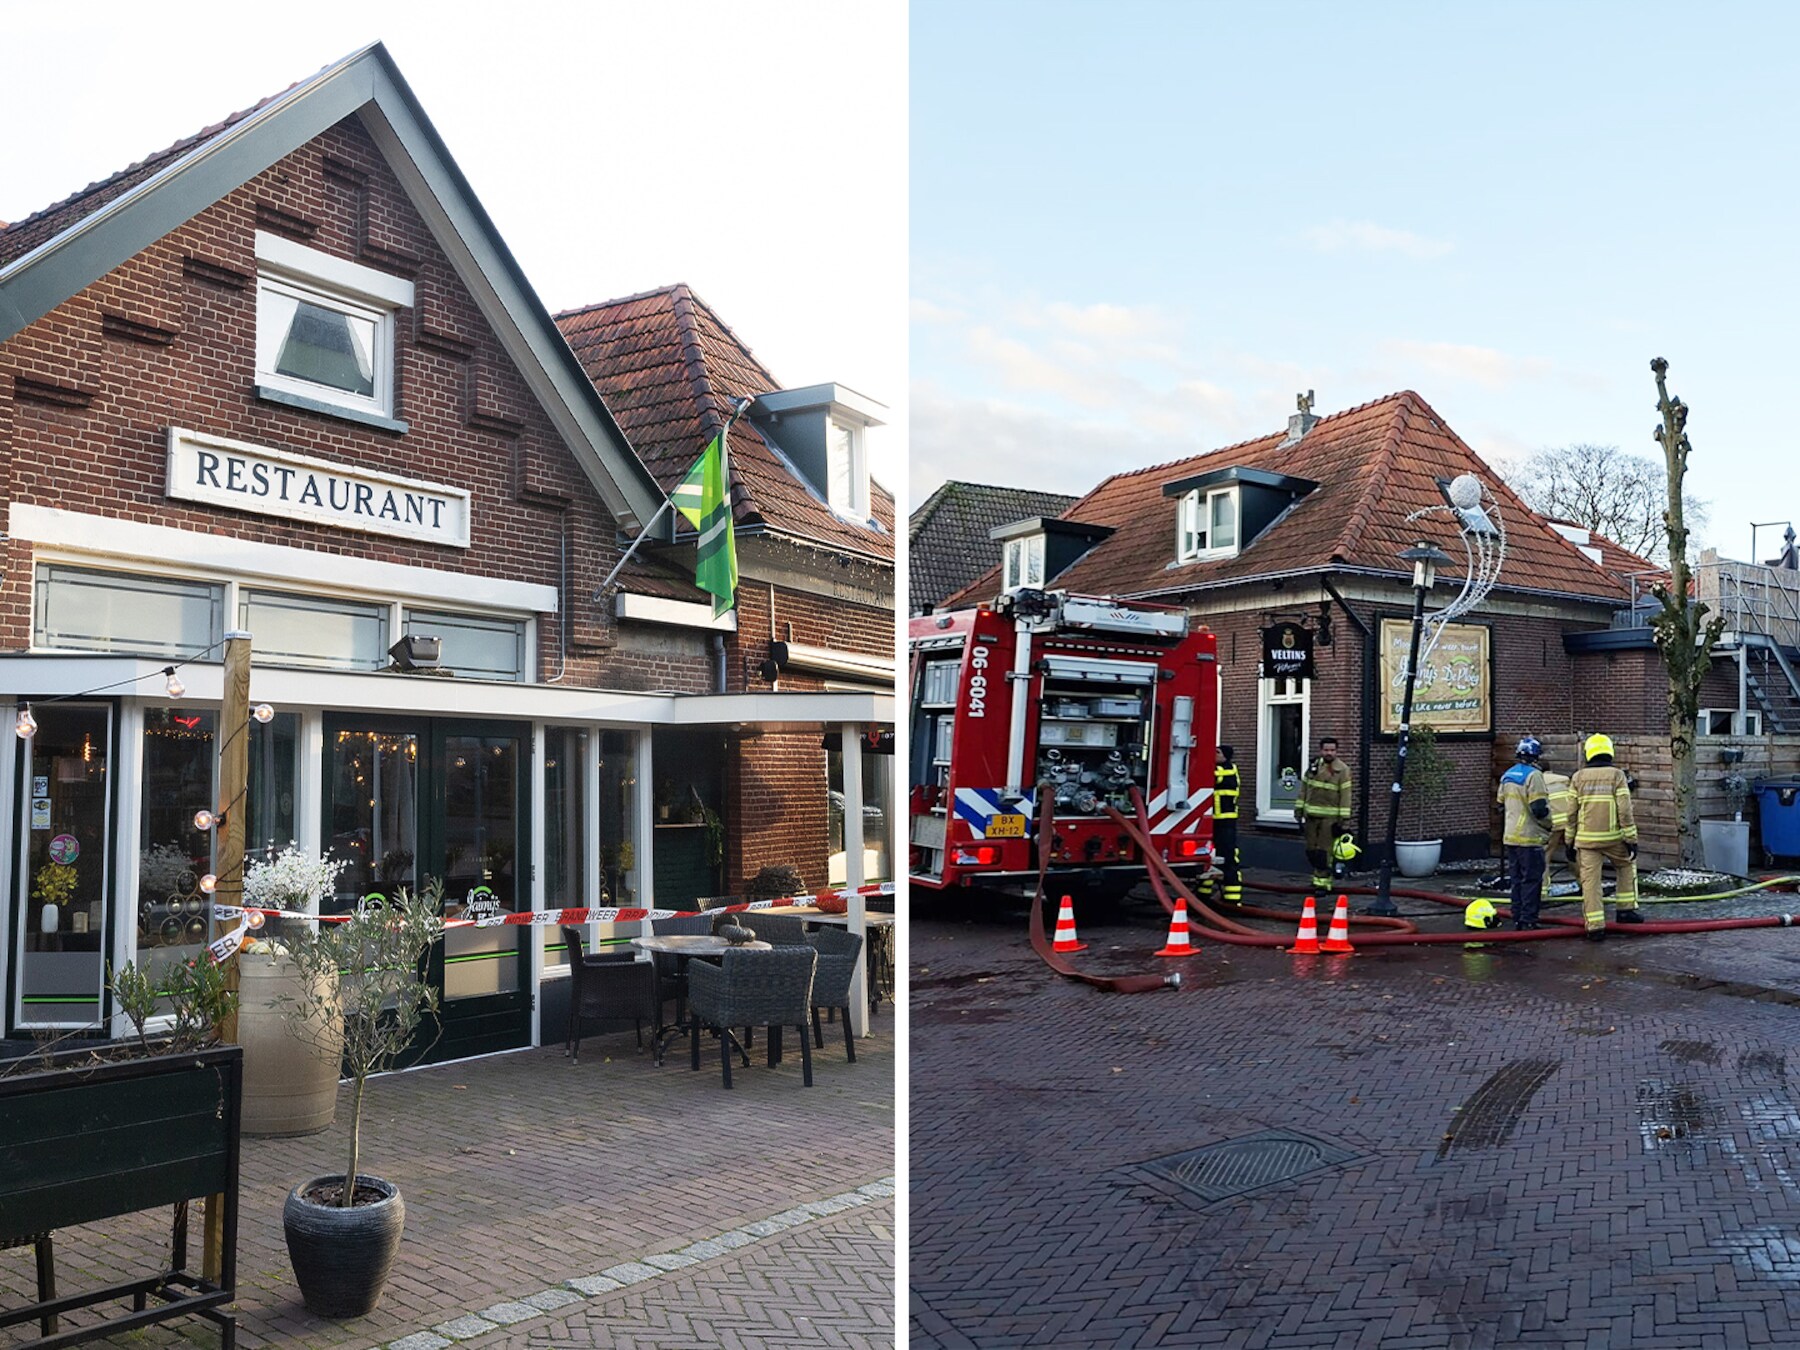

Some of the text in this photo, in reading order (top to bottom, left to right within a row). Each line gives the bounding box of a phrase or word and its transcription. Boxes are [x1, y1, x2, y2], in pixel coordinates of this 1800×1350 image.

[196, 451, 446, 528] RESTAURANT
[1271, 649, 1306, 660] VELTINS
[968, 646, 989, 717] 06-6041
[1001, 816, 1014, 824] BX
[992, 826, 1019, 835] XH-12
[555, 909, 618, 923] BRANDWEER
